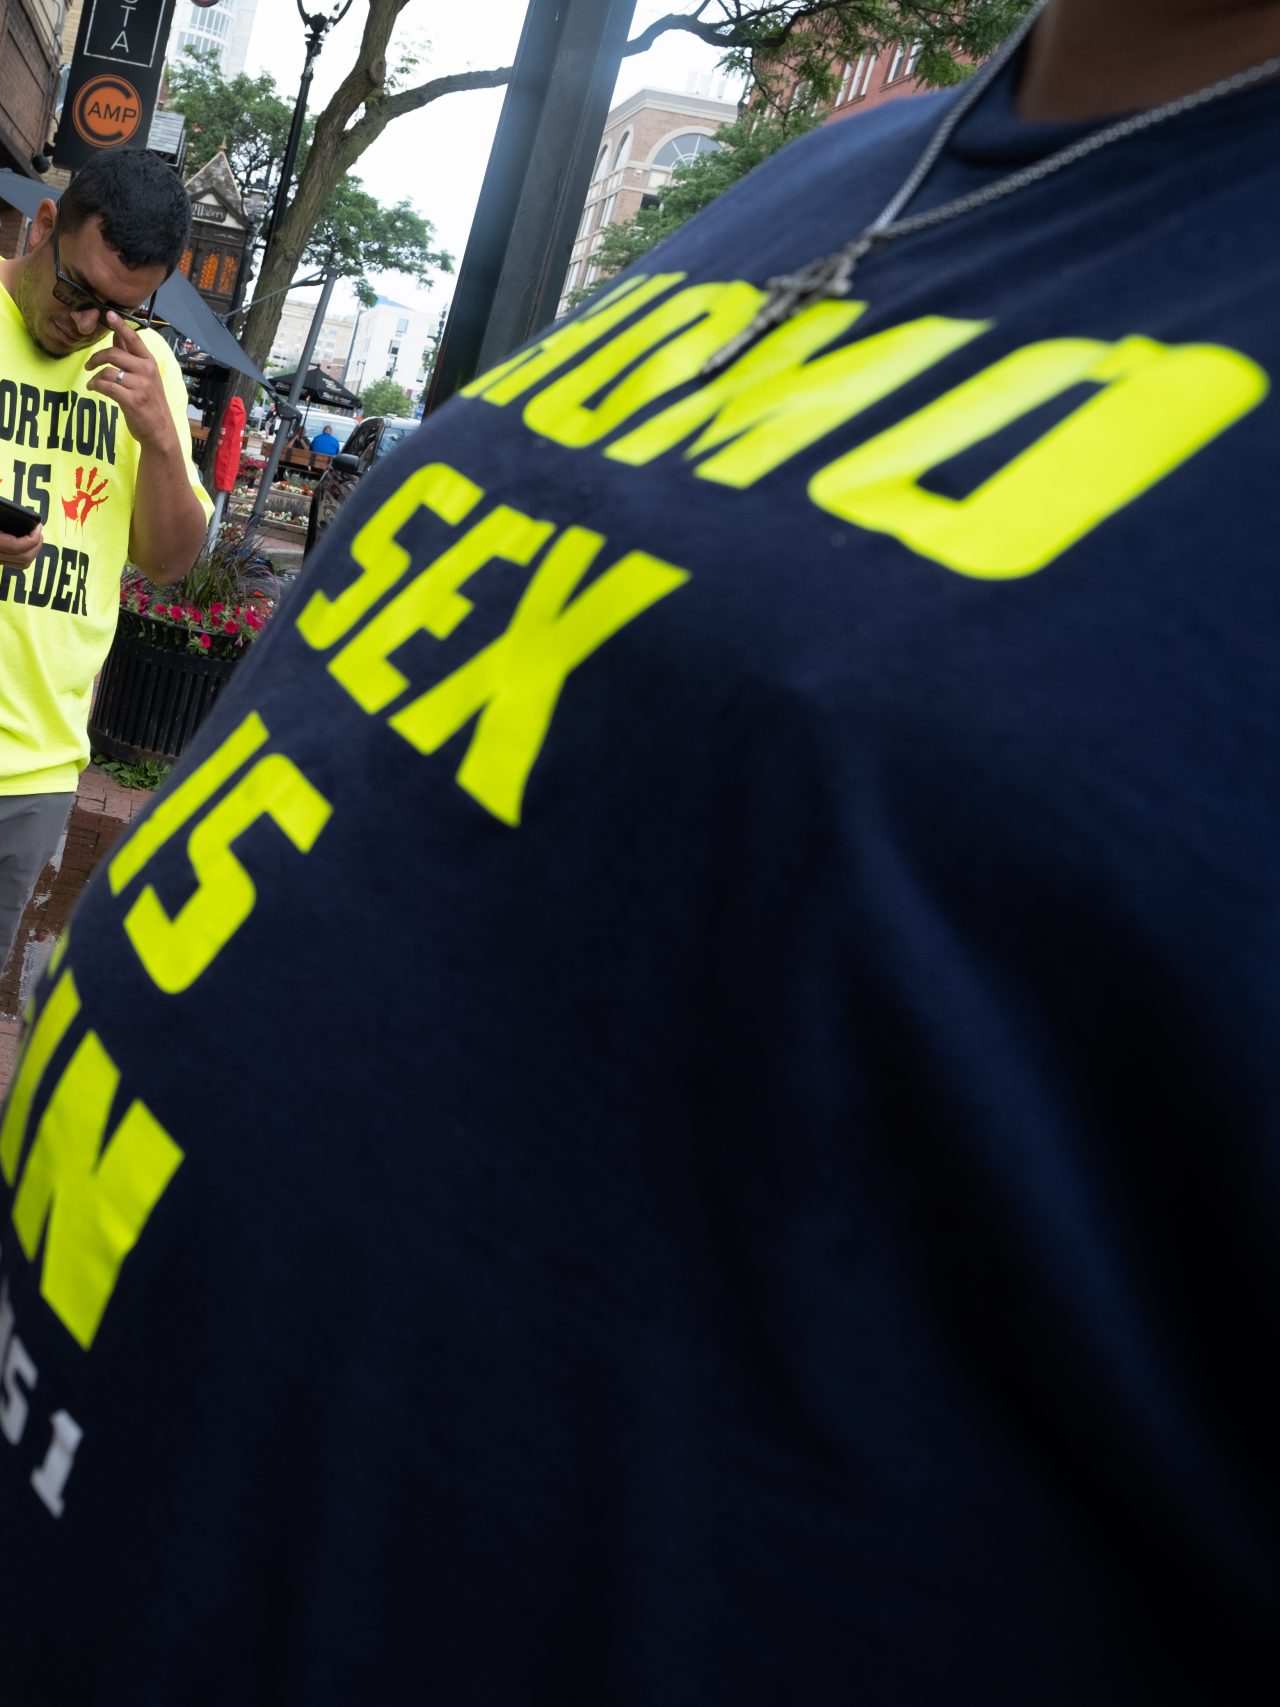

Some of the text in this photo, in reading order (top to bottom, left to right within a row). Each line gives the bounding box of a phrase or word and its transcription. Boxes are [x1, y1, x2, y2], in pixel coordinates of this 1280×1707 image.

[110, 0, 139, 53] TA
[13, 459, 52, 526] IS
[295, 462, 692, 829] SEX
[108, 710, 333, 994] IS
[30, 1408, 84, 1519] 1
